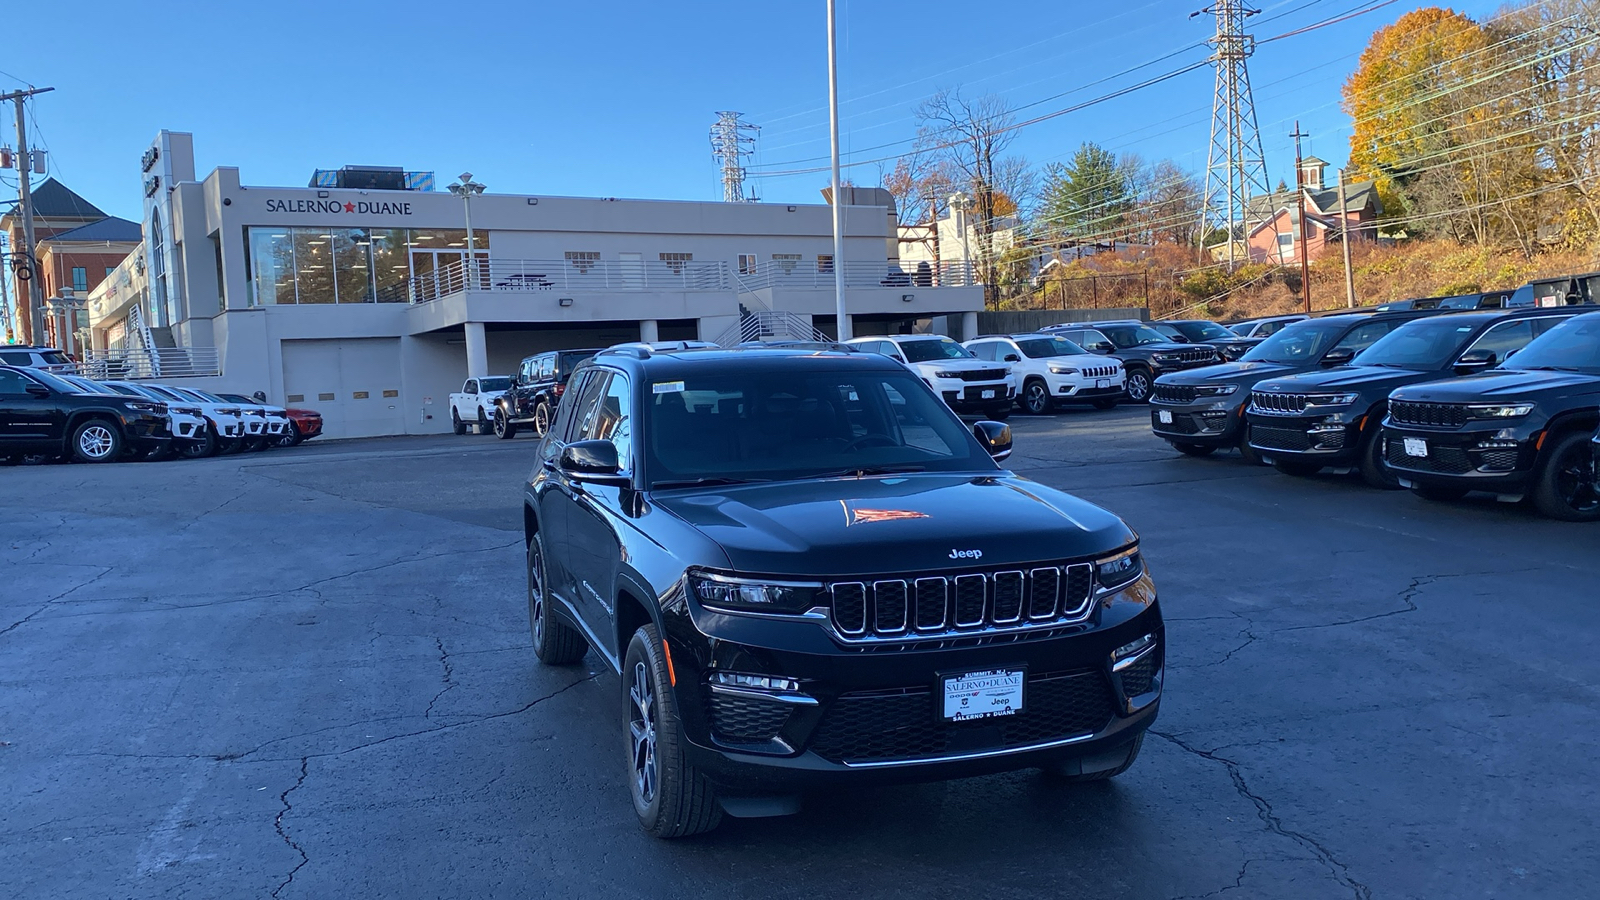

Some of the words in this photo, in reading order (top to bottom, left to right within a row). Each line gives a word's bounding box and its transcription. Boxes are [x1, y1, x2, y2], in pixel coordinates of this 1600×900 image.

[266, 199, 342, 214] SALERNO
[357, 201, 413, 215] DUANE
[948, 548, 983, 560] Jeep
[946, 680, 985, 691] SALERNO
[990, 676, 1020, 687] DUANE
[991, 698, 1010, 706] Jeep
[952, 713, 984, 721] SALERNO
[993, 709, 1016, 717] DUANE
